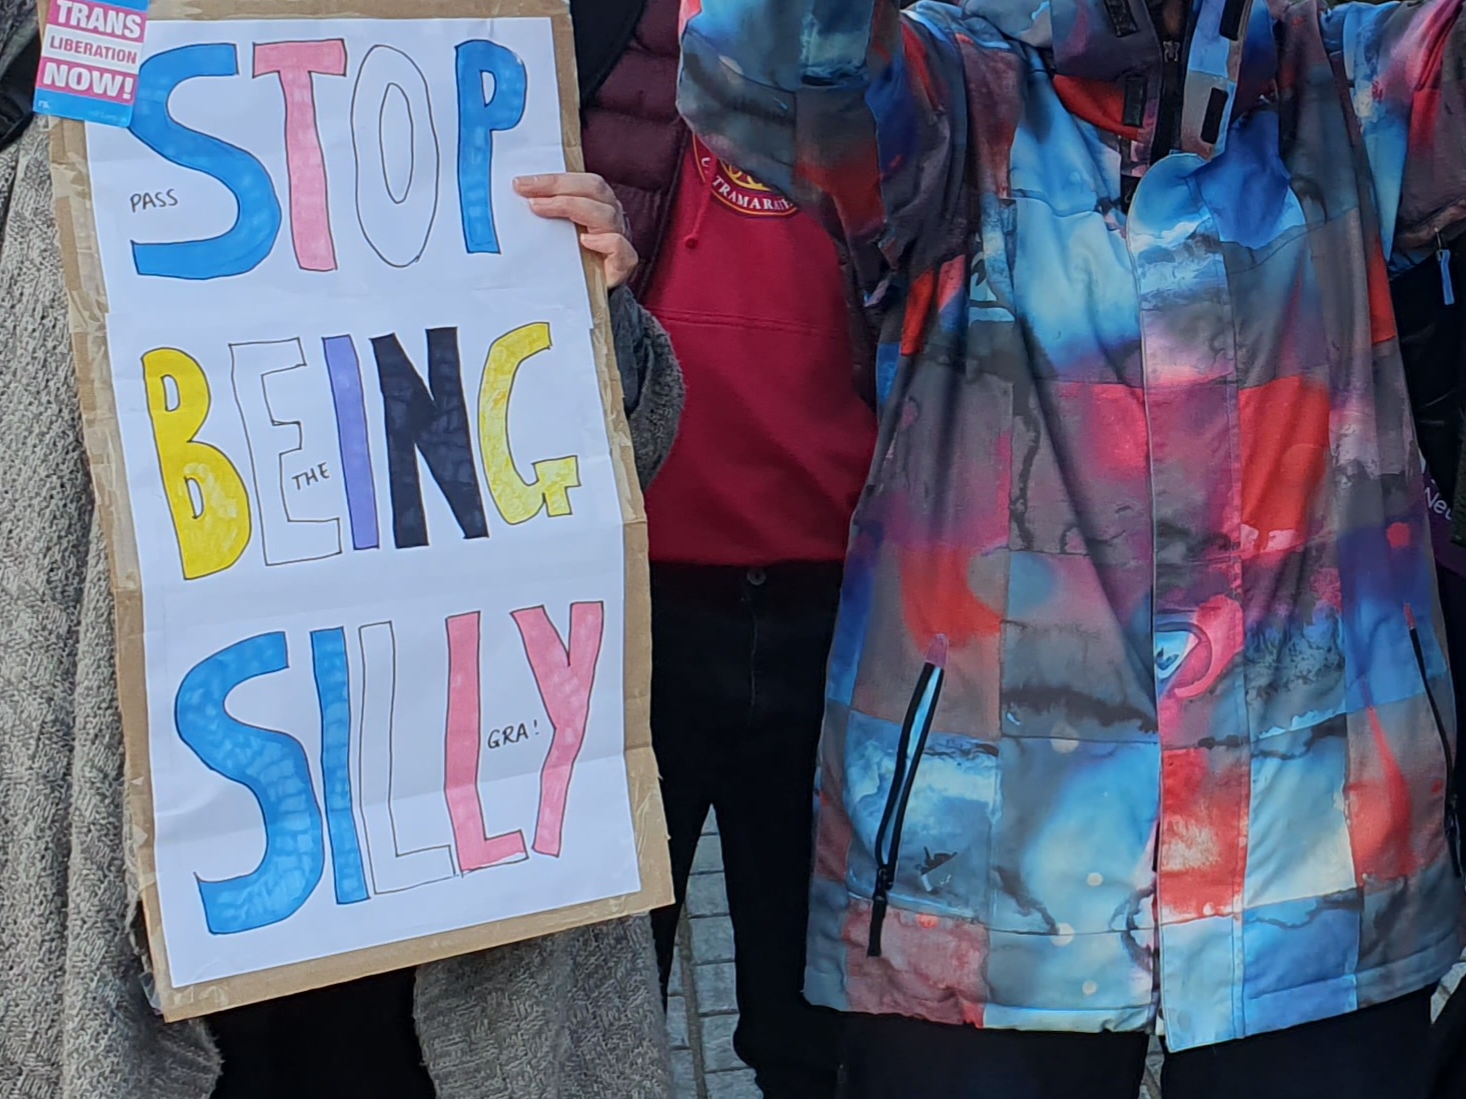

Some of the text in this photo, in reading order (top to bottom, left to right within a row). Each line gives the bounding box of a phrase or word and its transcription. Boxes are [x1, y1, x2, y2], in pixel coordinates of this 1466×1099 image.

[49, 34, 138, 65] LIBERATION
[42, 61, 135, 100] NOW!
[128, 38, 527, 280] STOP
[129, 188, 178, 213] PASS
[141, 322, 581, 581] BEING
[291, 461, 331, 491] THE
[486, 719, 542, 751] GRA!
[174, 600, 604, 935] SILLY
